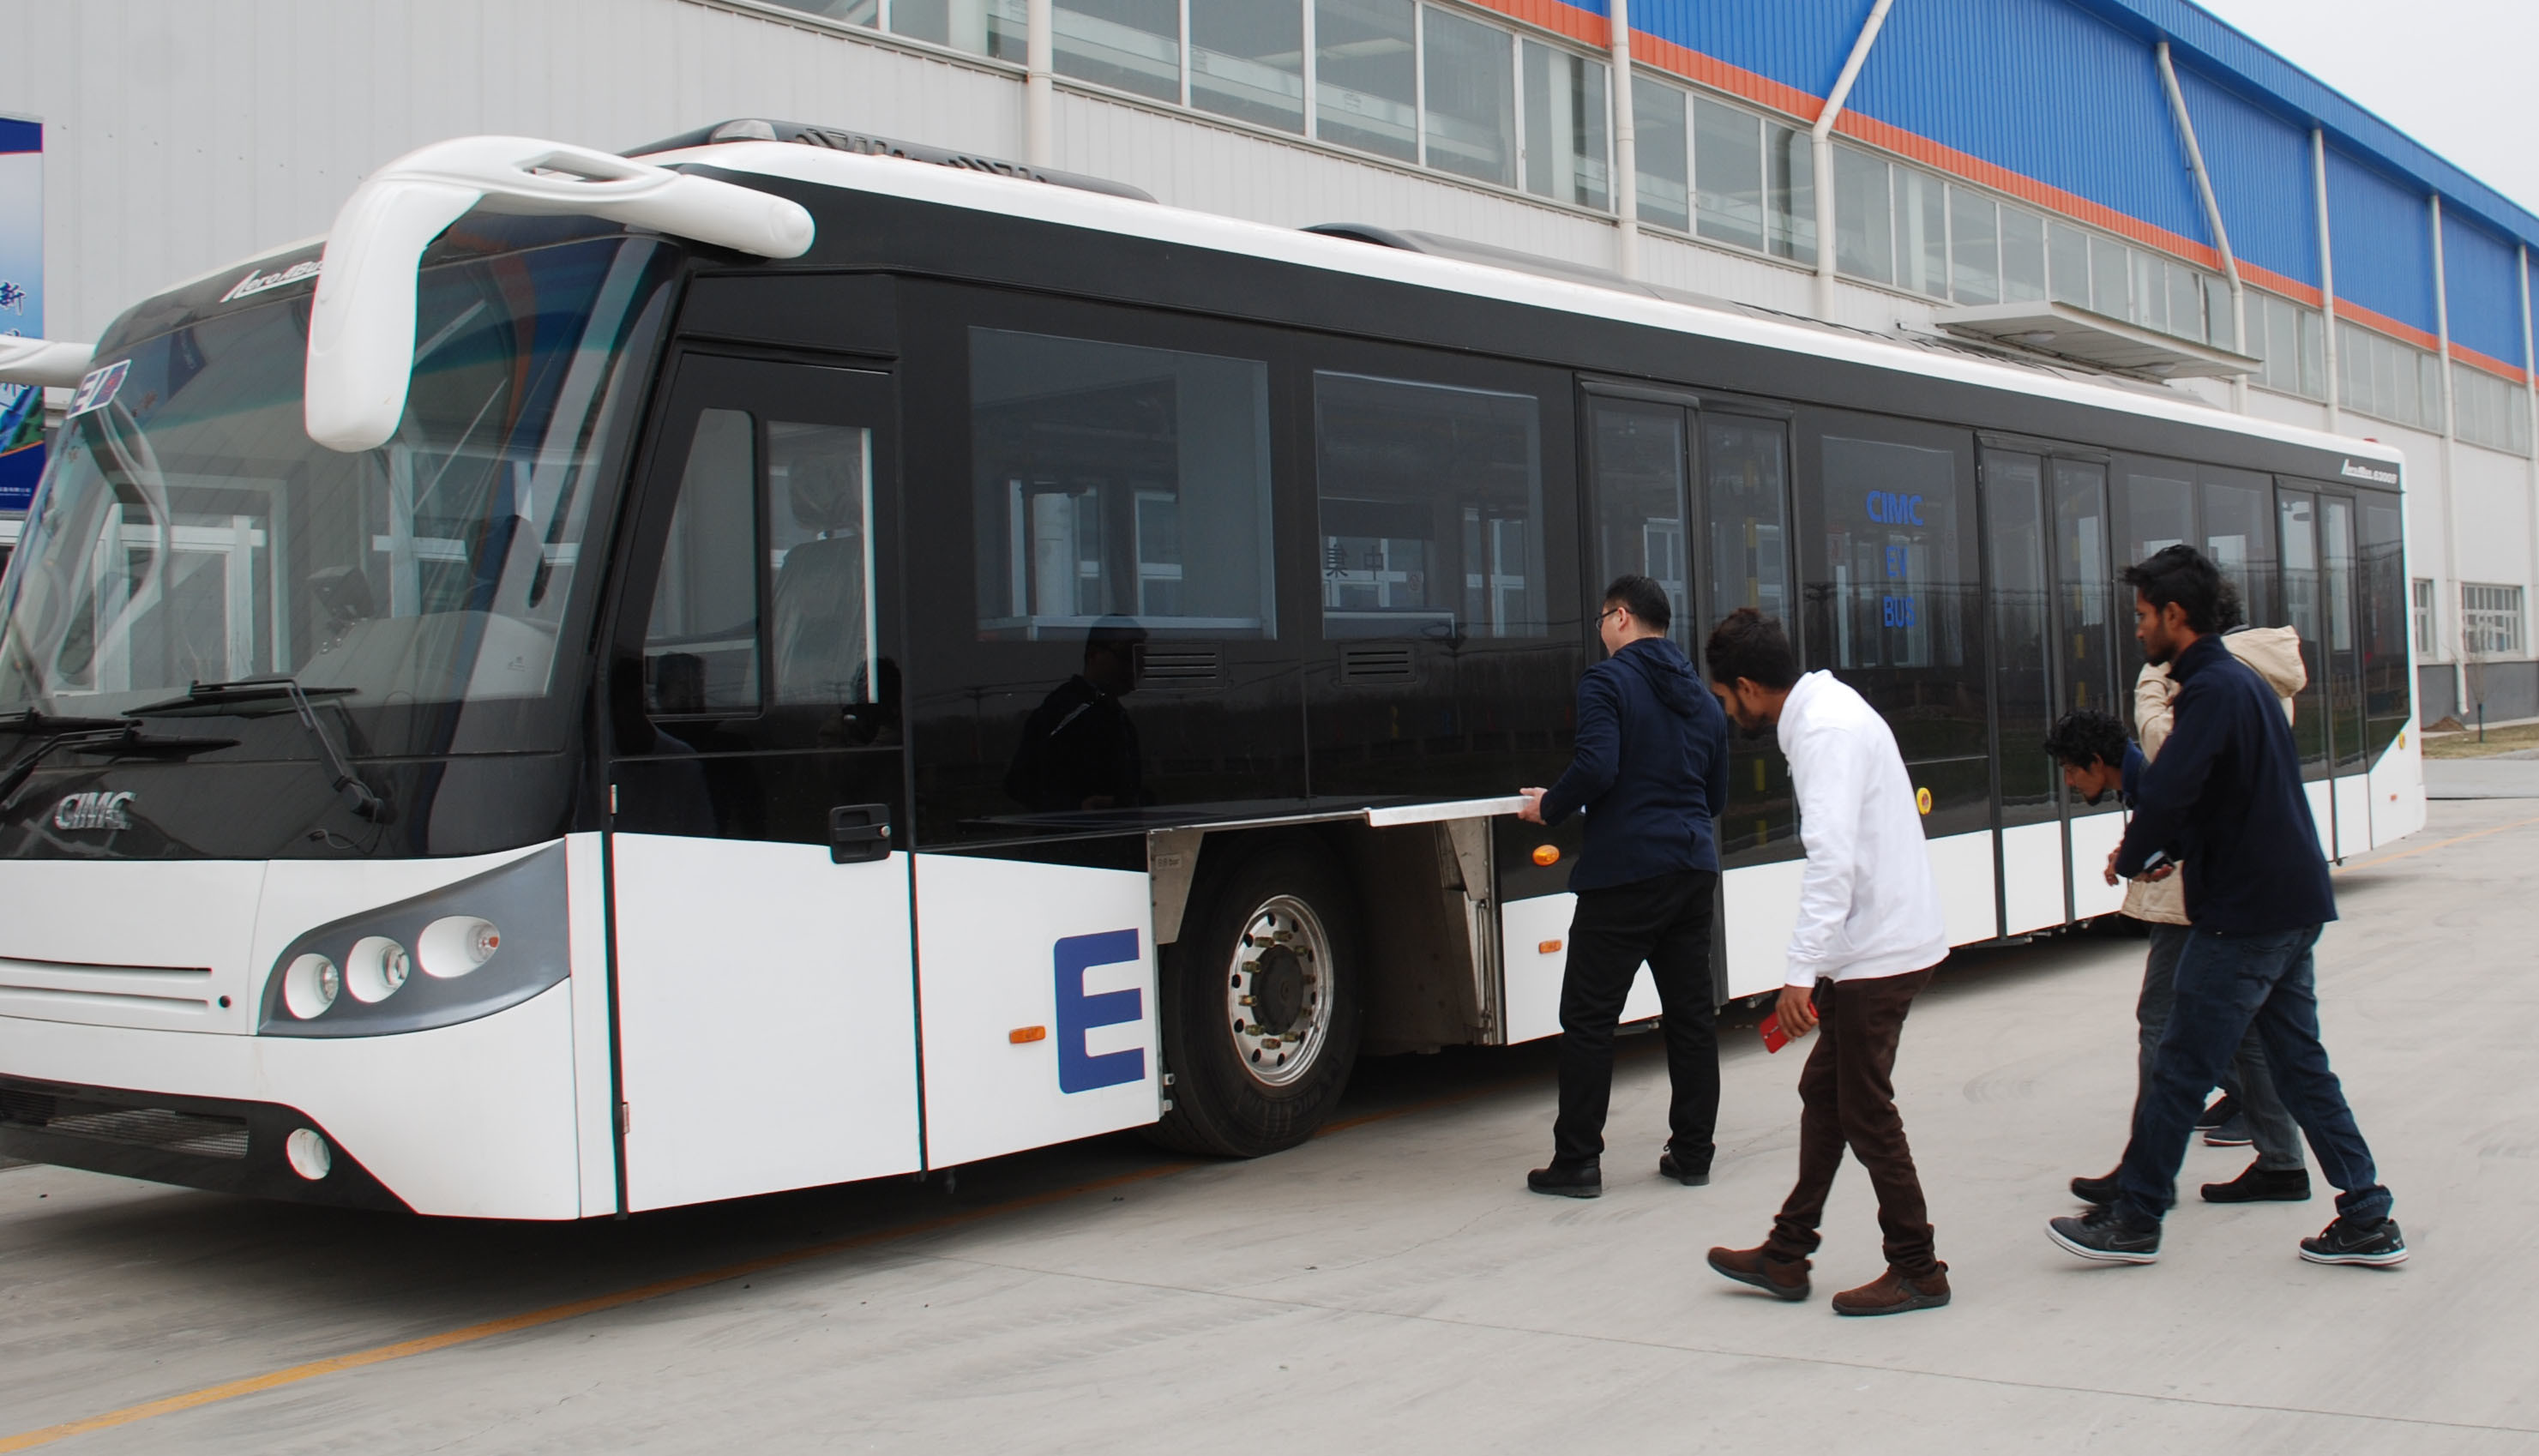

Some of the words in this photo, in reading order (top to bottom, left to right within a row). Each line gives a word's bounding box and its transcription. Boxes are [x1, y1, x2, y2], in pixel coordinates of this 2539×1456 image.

[1867, 490, 1924, 526] CIMC
[1886, 546, 1908, 577] EV
[1883, 596, 1916, 628] BUS
[55, 791, 137, 830] CIMC
[1054, 928, 1146, 1094] E
